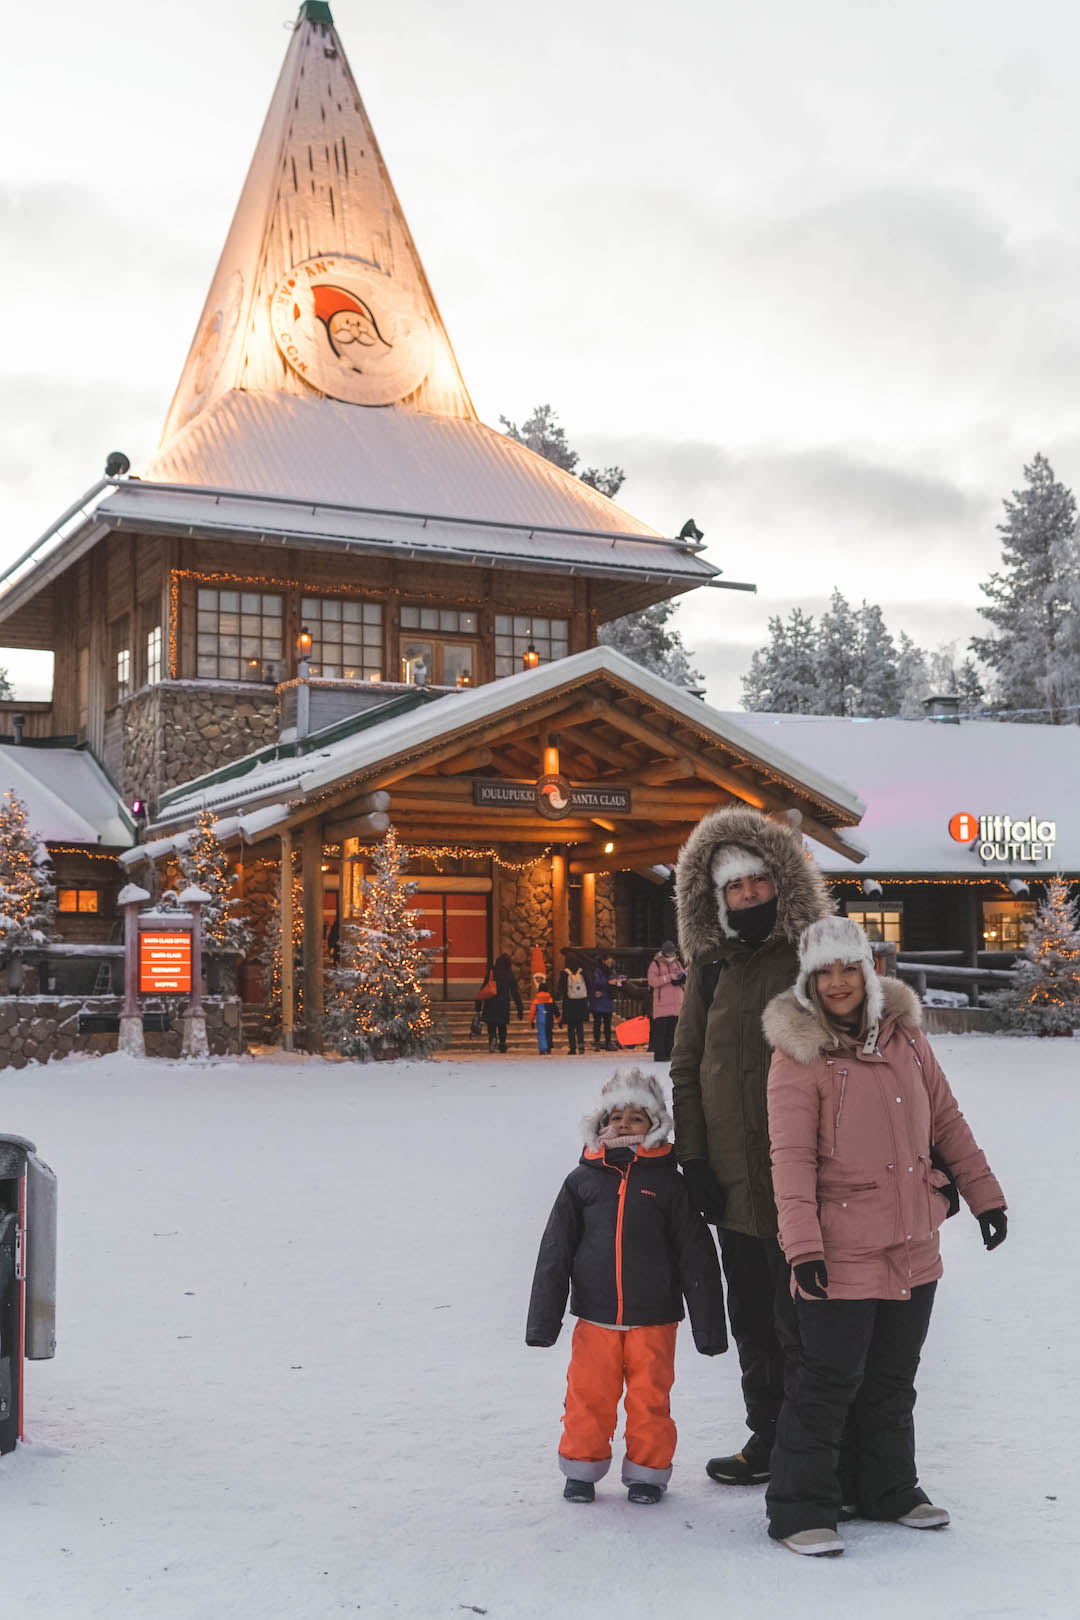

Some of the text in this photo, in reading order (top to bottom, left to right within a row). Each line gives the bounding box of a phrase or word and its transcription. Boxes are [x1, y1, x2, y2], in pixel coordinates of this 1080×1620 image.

[481, 787, 535, 801] JOULUPUKKI
[571, 793, 626, 806] SANTA CLAUS
[980, 815, 1057, 842] iittala
[980, 842, 1056, 861] OUTLET
